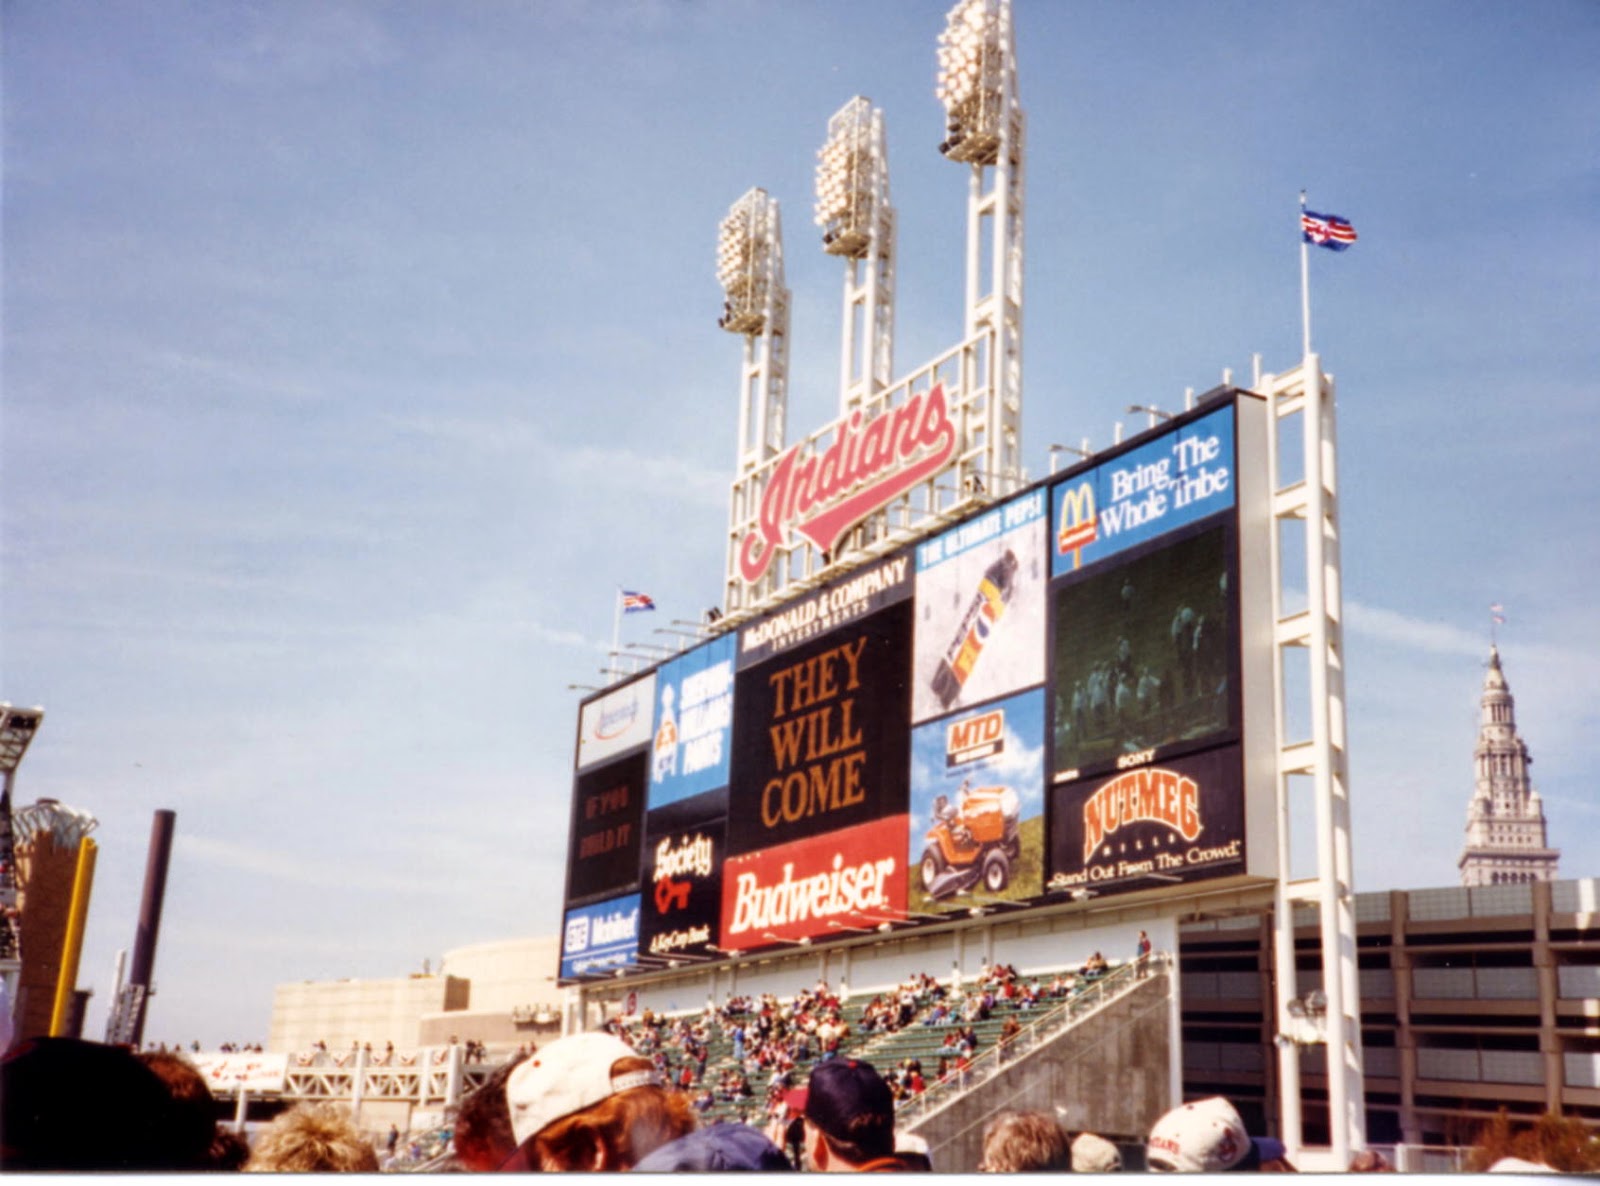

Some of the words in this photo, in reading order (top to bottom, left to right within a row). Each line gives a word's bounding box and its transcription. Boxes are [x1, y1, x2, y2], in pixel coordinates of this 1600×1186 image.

[739, 381, 956, 583] Indians
[1100, 490, 1168, 538] Whole
[1168, 467, 1229, 509] Tribe
[1111, 457, 1171, 503] Bring
[1172, 435, 1220, 472] The
[830, 555, 908, 611] COMPANY
[772, 598, 869, 651] INVESTMENTS
[768, 635, 868, 719] THEY
[769, 698, 863, 772] WILL
[950, 713, 1002, 750] MTD
[1117, 749, 1156, 769] SONY
[761, 750, 867, 828] COME
[1083, 768, 1201, 865] NUTMEG
[653, 832, 713, 882] Society
[1053, 867, 1089, 886] Stand
[1090, 865, 1115, 881] Out
[1118, 860, 1154, 877] From
[1154, 852, 1184, 870] The
[729, 853, 896, 934] Budweiser
